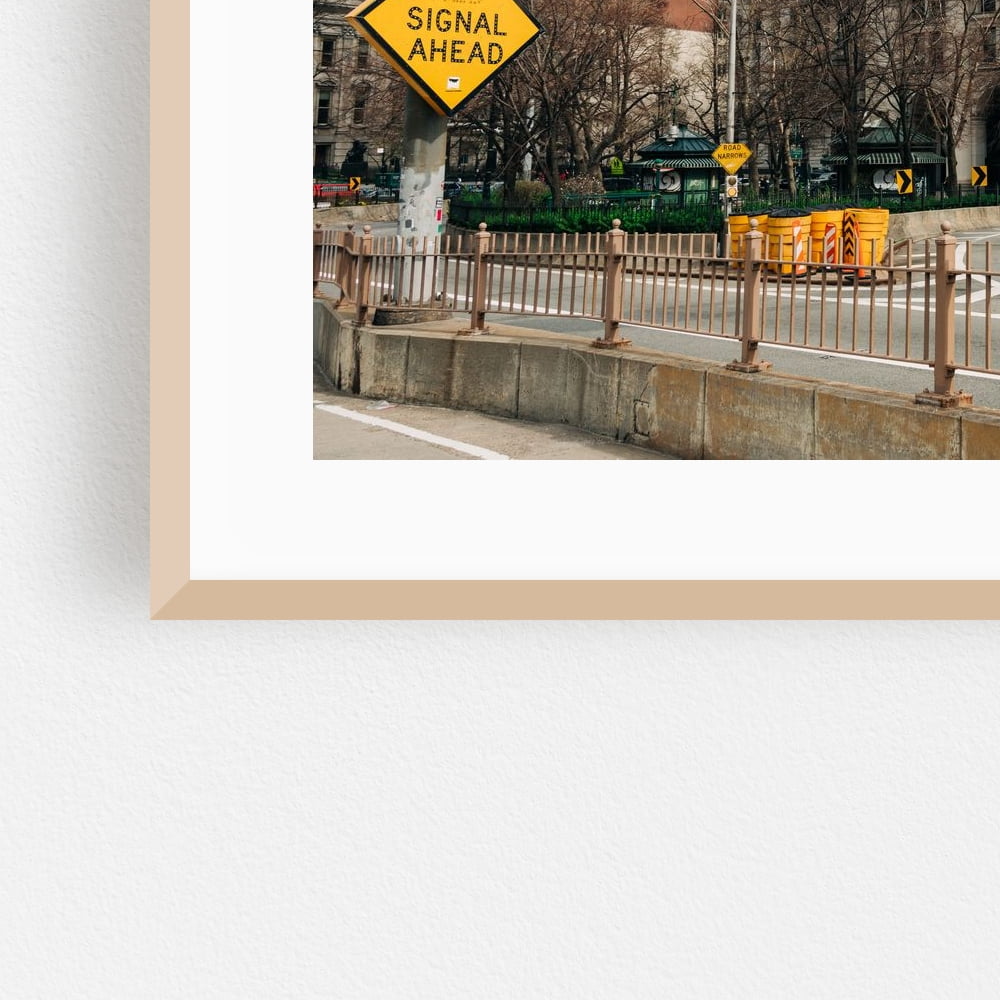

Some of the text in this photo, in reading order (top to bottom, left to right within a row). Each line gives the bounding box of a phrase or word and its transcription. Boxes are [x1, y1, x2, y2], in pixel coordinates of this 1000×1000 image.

[406, 6, 507, 36] SIGNAL
[407, 37, 504, 65] AHEAD
[717, 152, 748, 160] NARROWS
